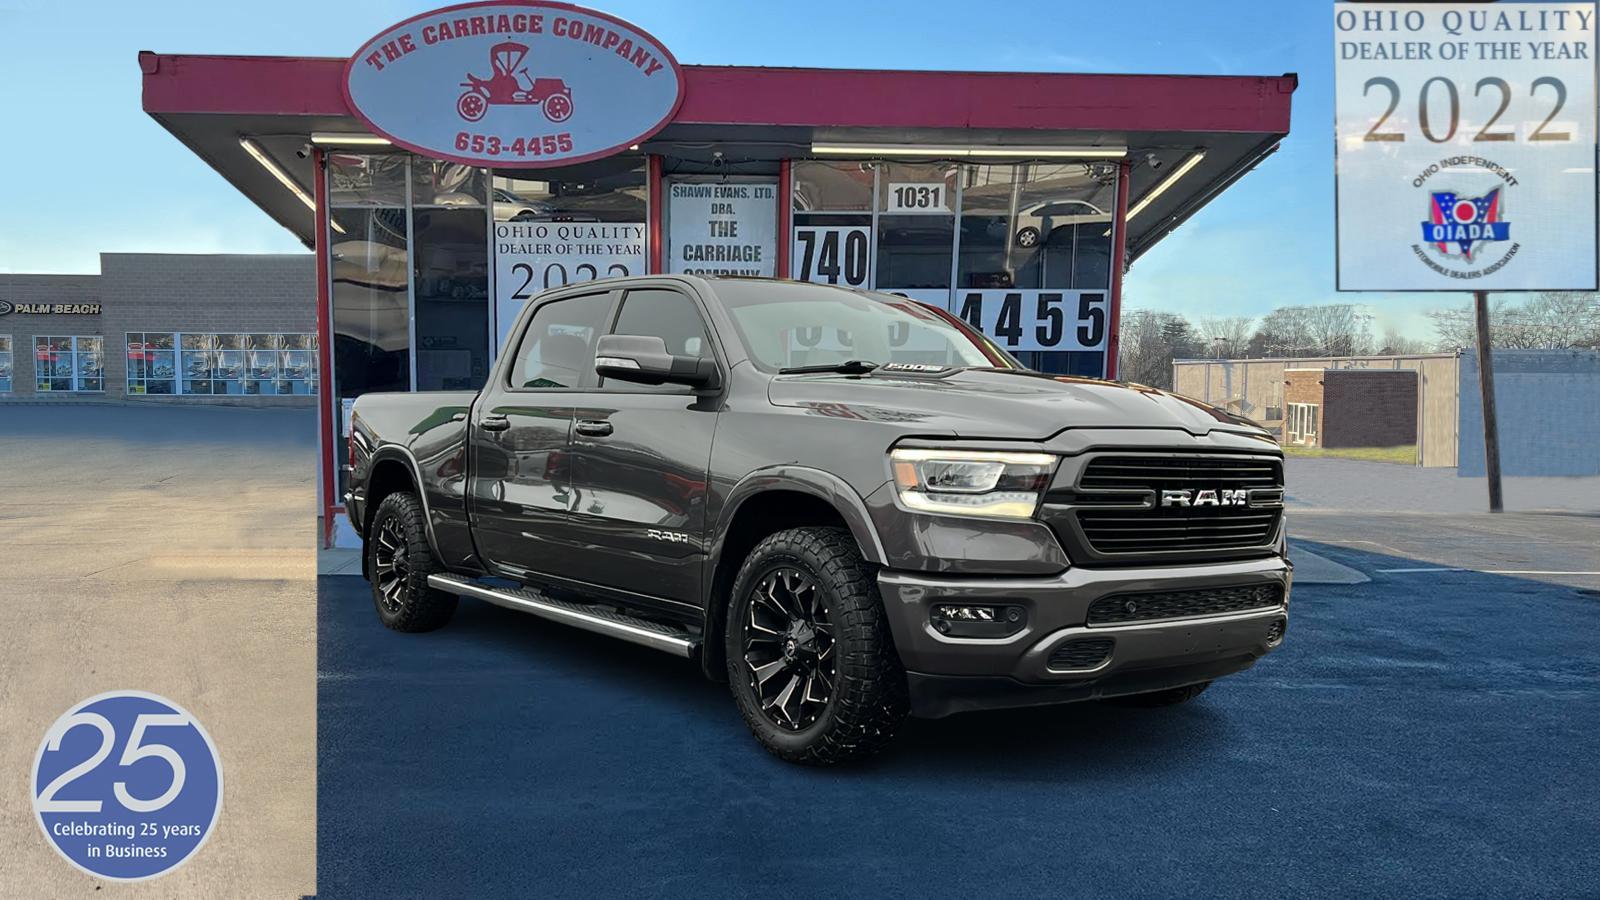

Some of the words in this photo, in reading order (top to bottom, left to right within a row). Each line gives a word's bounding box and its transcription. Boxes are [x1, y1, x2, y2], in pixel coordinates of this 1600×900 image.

[1336, 10, 1425, 31] OHIO
[1442, 9, 1593, 36] QUALITY
[365, 33, 417, 72] THE
[422, 14, 544, 45] CARRIAGE
[552, 16, 664, 77] COMPANY
[1340, 41, 1433, 60] DEALER
[1438, 41, 1469, 60] OF
[1474, 41, 1522, 60] THE
[1527, 41, 1589, 60] YEAR
[1362, 76, 1571, 143] 2022
[455, 131, 574, 157] 653-4455
[1412, 163, 1440, 188] OHIO
[1440, 155, 1519, 187] INDEPENDENT
[672, 185, 712, 199] SHAWN
[754, 187, 775, 200] LTD.
[894, 186, 941, 209] 1031
[711, 203, 736, 216] DBA.
[497, 226, 548, 239] OHIO
[557, 226, 644, 241] QUALITY
[709, 220, 738, 238] THE
[1432, 224, 1495, 240] OIADA
[500, 243, 552, 255] DEALER
[555, 243, 574, 255] OF
[576, 243, 604, 255] THE
[606, 244, 642, 256] YEAR
[683, 244, 762, 262] CARRIAGE
[797, 230, 868, 286] 740
[14, 303, 51, 314] PALM
[54, 303, 101, 314] BEACH
[1160, 489, 1247, 507] RAM
[647, 528, 689, 544] RAM
